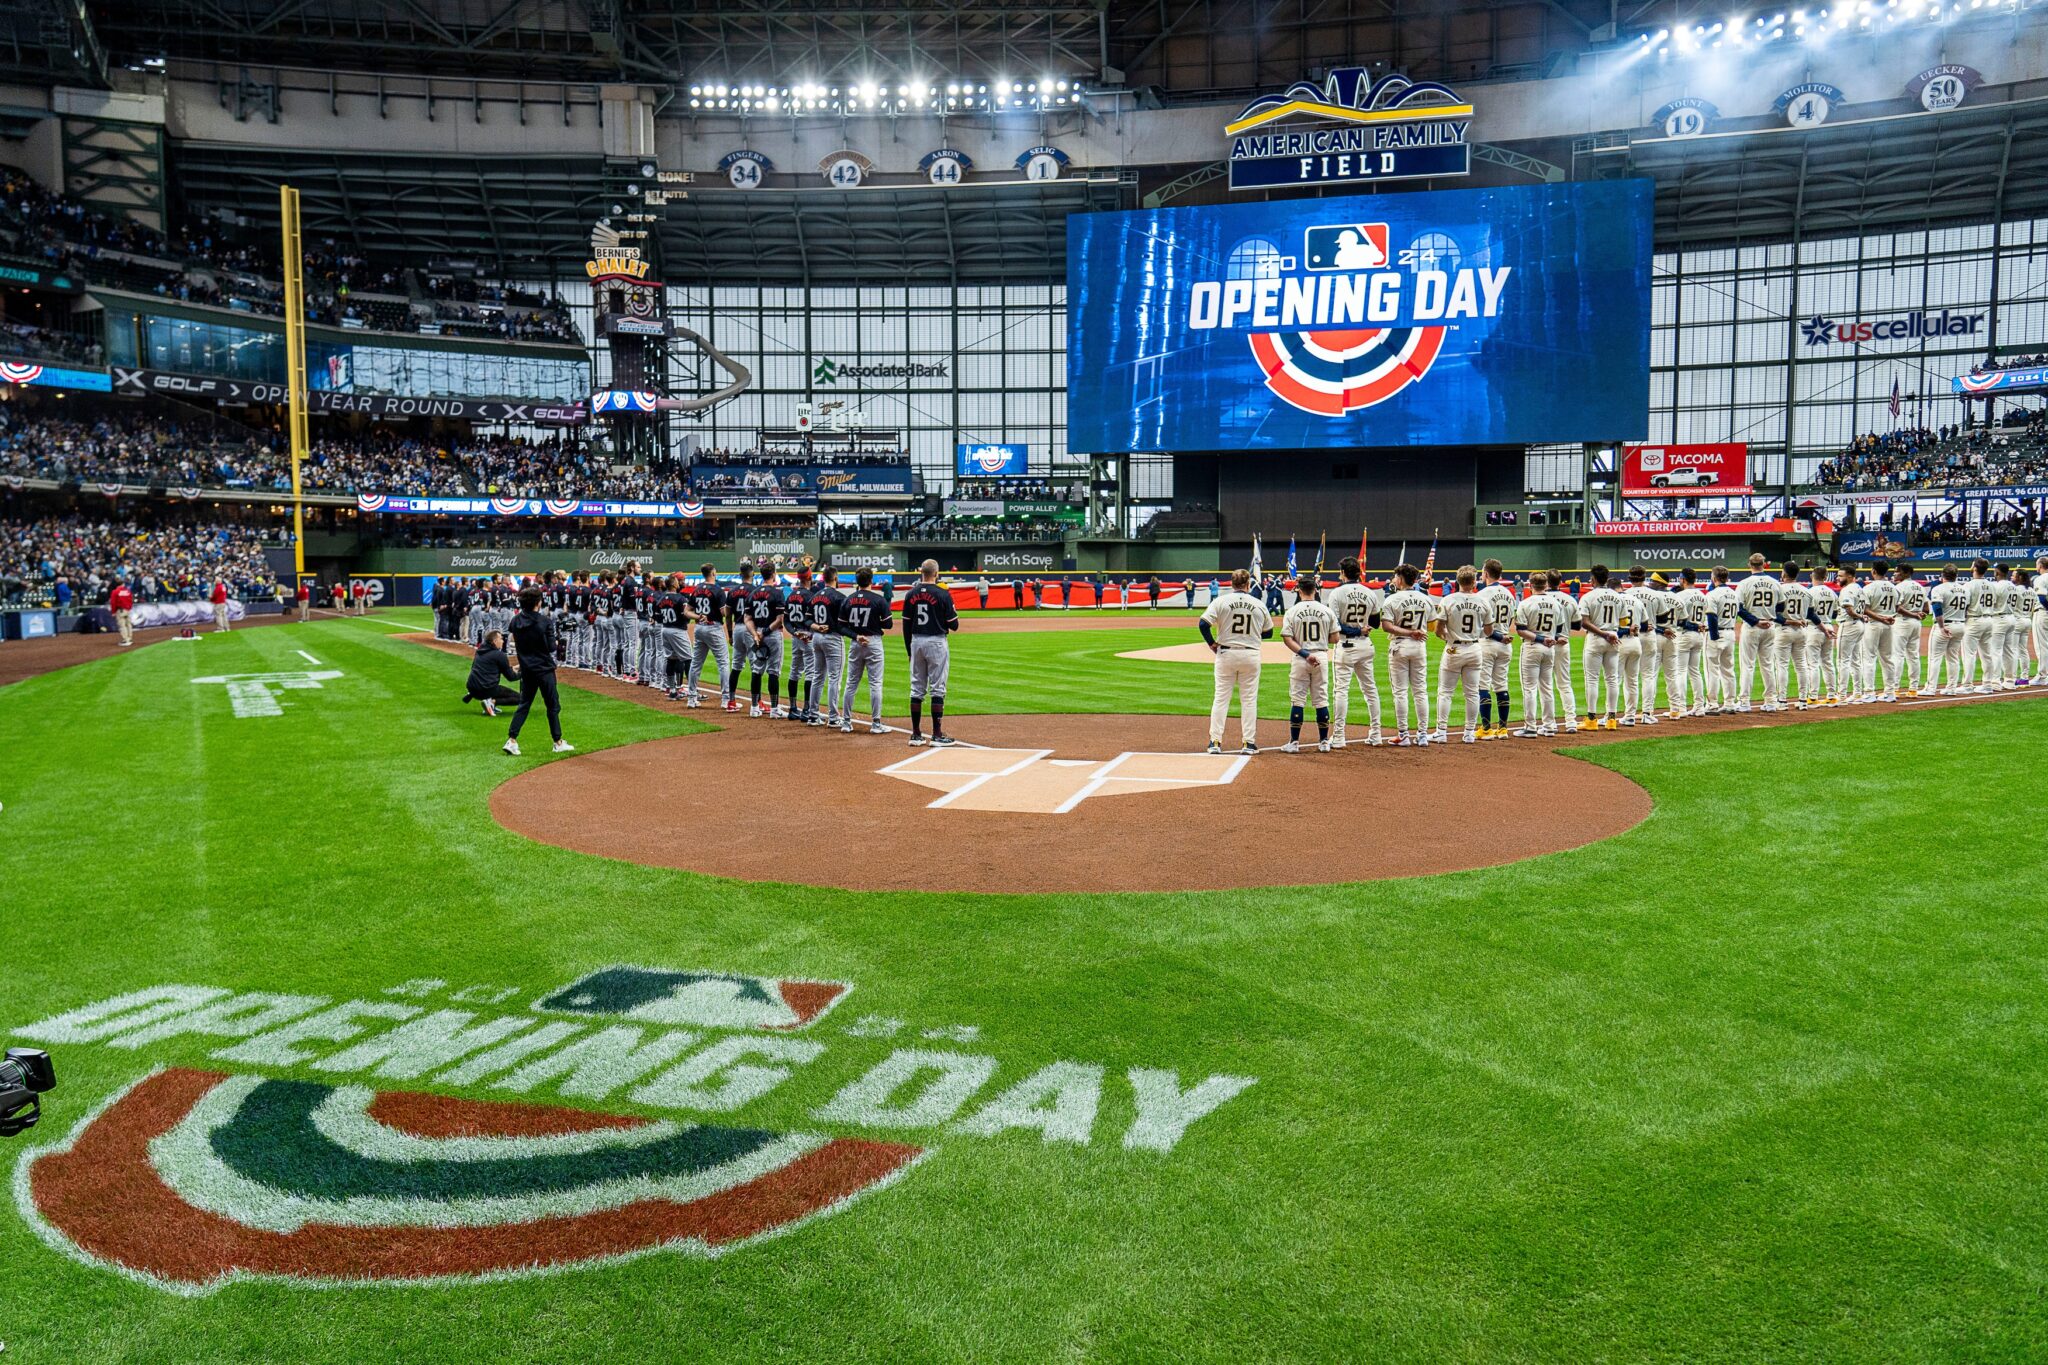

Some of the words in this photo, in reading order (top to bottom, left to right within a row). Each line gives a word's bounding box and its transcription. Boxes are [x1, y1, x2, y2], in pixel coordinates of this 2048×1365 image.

[1919, 65, 1966, 81] UECKER
[1783, 84, 1833, 100] MOLITOR
[1929, 79, 1957, 98] 50
[1668, 98, 1704, 110] YOUNT
[1799, 100, 1815, 120] 4
[1671, 114, 1699, 135] 19
[1231, 128, 1365, 159] AMERICAN
[1373, 121, 1470, 149] FAMILY
[727, 151, 764, 163] FINGERS
[931, 150, 960, 159] AARON
[1029, 146, 1056, 156] SELIG
[933, 164, 957, 182] 44
[1038, 161, 1048, 180] 1
[1300, 152, 1396, 178] FIELD
[657, 172, 696, 183] GONE!
[733, 165, 759, 184] 34
[833, 165, 859, 184] 42
[645, 190, 662, 198] GET
[662, 191, 689, 199] OUTTA
[627, 214, 643, 222] GET
[645, 214, 657, 222] UP
[619, 230, 634, 238] GET
[636, 231, 648, 239] UP
[595, 247, 640, 259] BERNIE'S
[1258, 255, 1297, 272] 20
[1398, 248, 1438, 266] 24
[585, 258, 650, 278] CHALET
[1189, 271, 1402, 330] OPENING
[1413, 266, 1513, 321] DAY
[1836, 309, 1985, 344] uscellular
[153, 375, 217, 393] GOLF
[2010, 374, 2040, 382] 2024
[252, 385, 311, 405] OPEN
[319, 392, 372, 412] YEAR
[385, 397, 464, 416] ROUND
[533, 408, 587, 420] GOLF
[797, 407, 811, 417] Lite
[1668, 453, 1724, 465] TACOMA
[816, 473, 857, 491] Miller
[837, 483, 859, 492] TIME,
[859, 483, 905, 492] MILWAUKEE
[1964, 489, 1989, 498] GREAT
[1990, 488, 2014, 497] TASTE.
[2015, 487, 2026, 495] 96
[1598, 523, 1641, 533] TOYOTA
[1643, 521, 1704, 532] TERRITORY
[749, 540, 805, 554] Johnsonville
[1633, 548, 1726, 560] TOYOTA.COM
[1840, 539, 1873, 555] Culver's
[1949, 549, 1982, 558] WELCOME
[1994, 548, 2028, 558] DELICIOUS
[451, 555, 487, 567] Barrel
[488, 555, 518, 569] Yard
[590, 550, 628, 568] Bally
[626, 555, 653, 565] SPORTS
[843, 552, 895, 568] impact
[984, 554, 1010, 566] Pick
[1022, 554, 1053, 566] Save
[1346, 592, 1368, 601] YELICH
[1401, 599, 1427, 609] ADAMES
[1752, 591, 1773, 607] 29
[1880, 595, 1894, 610] 41
[1908, 593, 1924, 608] 45
[1950, 596, 1967, 610] 46
[1980, 593, 1993, 607] 48
[2007, 593, 2018, 607] 49
[695, 597, 711, 615] 38
[753, 600, 769, 619] 26
[788, 603, 804, 622] 25
[1228, 603, 1256, 612] MURPHY
[1346, 603, 1367, 623] 22
[1456, 604, 1482, 613] BAUERS
[1722, 602, 1737, 618] 20
[1787, 598, 1801, 615] 31
[1817, 600, 1834, 616] 37
[2023, 598, 2034, 612] 51
[660, 607, 677, 623] 30
[813, 604, 828, 624] 19
[848, 607, 871, 627] 47
[917, 603, 929, 625] 5
[1296, 611, 1326, 620] FRELICK
[1400, 610, 1425, 630] 27
[1495, 604, 1509, 624] 12
[1603, 605, 1614, 623] 11
[1692, 606, 1704, 622] 16
[1231, 614, 1252, 635] 21
[1461, 614, 1474, 634] 9
[1536, 613, 1554, 632] 15
[1303, 621, 1320, 642] 10
[10, 983, 827, 1112] OPENING
[808, 1046, 1258, 1153] DAY
